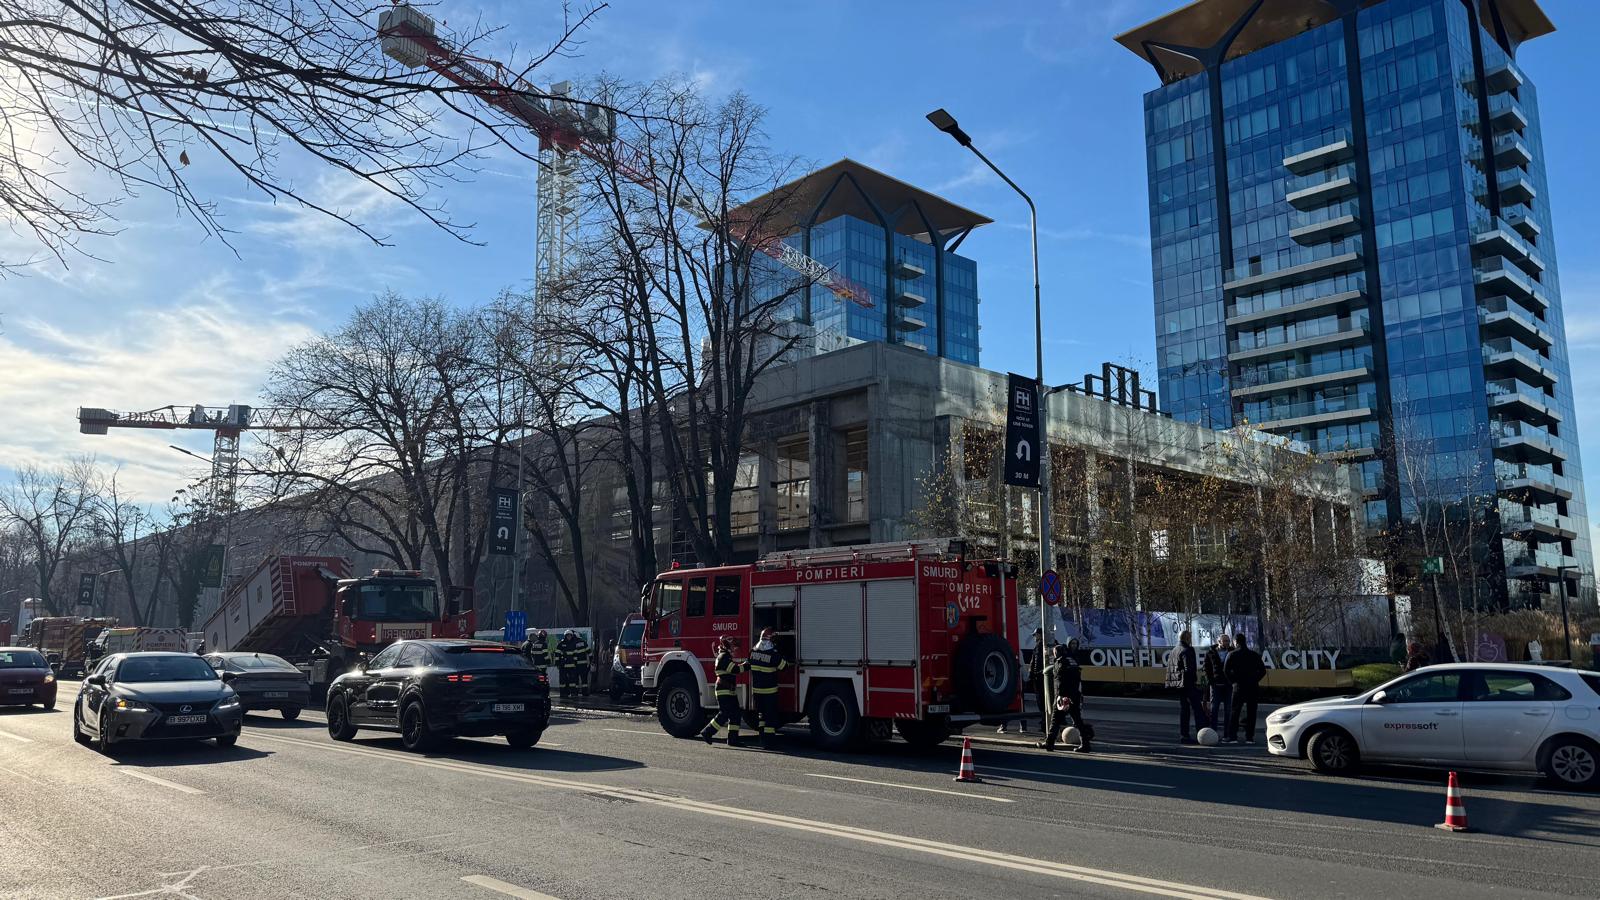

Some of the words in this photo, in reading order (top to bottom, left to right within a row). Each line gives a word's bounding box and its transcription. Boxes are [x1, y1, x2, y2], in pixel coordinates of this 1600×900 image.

[1016, 391, 1030, 406] FH
[499, 496, 510, 506] FH
[796, 566, 864, 581] POMPIERI
[923, 566, 958, 578] SMURD
[945, 582, 992, 595] OMPIERI
[965, 596, 980, 608] 112
[712, 622, 738, 631] SMURD
[1090, 648, 1134, 667] ONE
[1281, 649, 1341, 670] CITY
